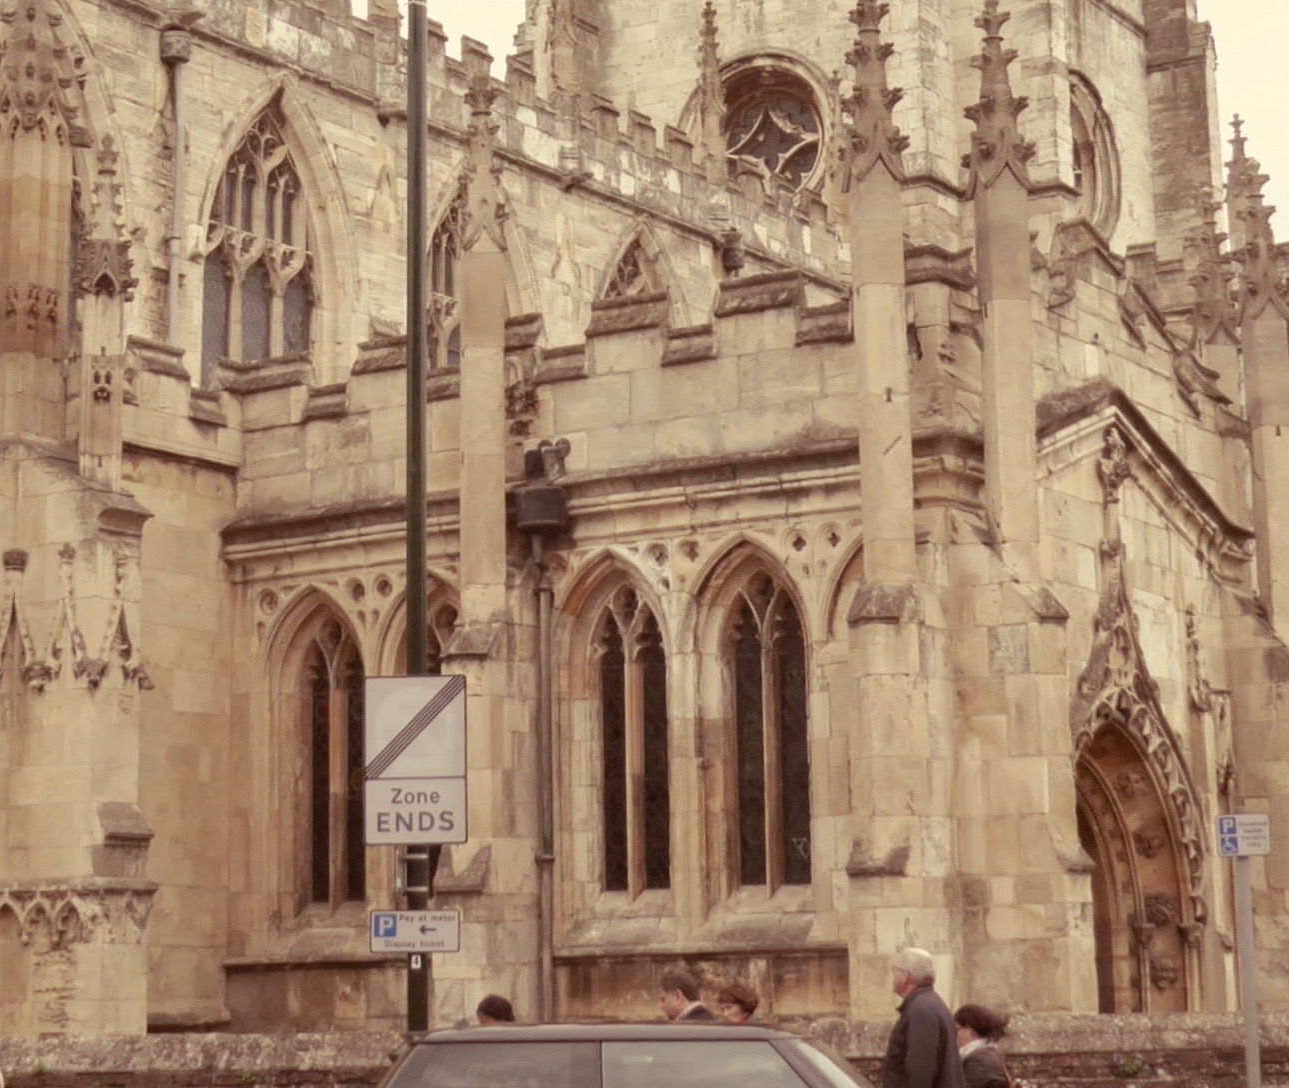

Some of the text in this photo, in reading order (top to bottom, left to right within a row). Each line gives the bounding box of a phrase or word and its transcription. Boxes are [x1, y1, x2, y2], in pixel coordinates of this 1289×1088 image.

[391, 788, 440, 804] Zone
[377, 811, 454, 832] ENDS
[1223, 819, 1233, 833] P
[399, 914, 415, 922] Pay
[379, 916, 394, 936] P
[384, 941, 415, 949] Display
